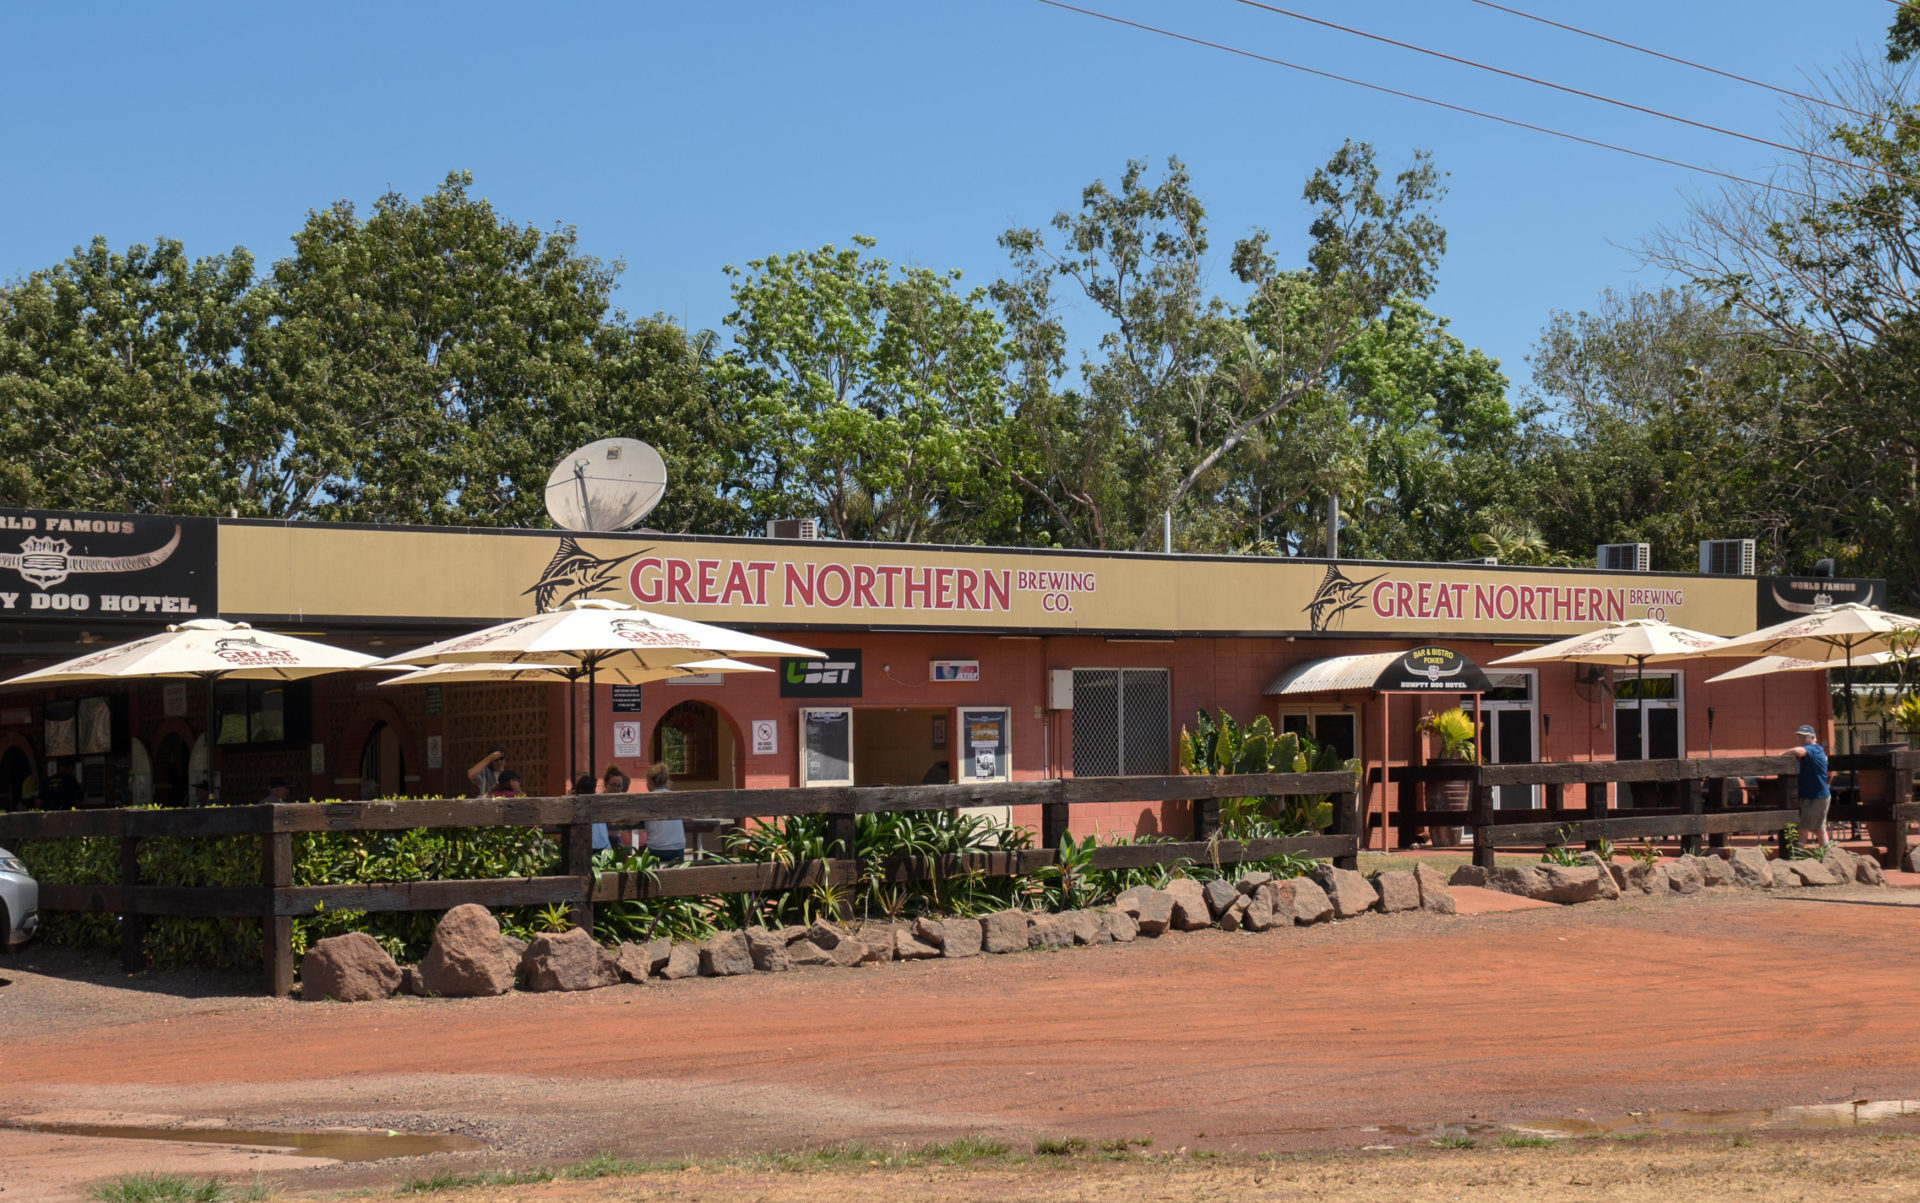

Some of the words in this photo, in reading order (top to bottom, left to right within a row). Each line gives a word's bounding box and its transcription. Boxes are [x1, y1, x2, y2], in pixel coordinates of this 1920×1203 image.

[45, 518, 136, 534] FAMOUS
[629, 557, 776, 606] GREAT
[783, 562, 1012, 612] NORTHERN
[1017, 570, 1096, 593] BREWING
[1790, 581, 1820, 591] WORLD
[1823, 582, 1856, 592] FAMOUS
[30, 593, 90, 610] DOO
[100, 594, 198, 613] HOTEL
[1042, 593, 1073, 613] CO.
[1372, 580, 1469, 620] GREAT
[1474, 583, 1626, 622] NORTHERN
[1629, 588, 1683, 606] BREWING
[1646, 606, 1668, 622] CO.
[617, 631, 692, 640] GREAT
[218, 650, 292, 658] GREAT
[1413, 649, 1425, 659] BAR
[1426, 648, 1431, 656] &
[1431, 648, 1454, 659] BISTRO
[955, 672, 978, 680] ATM
